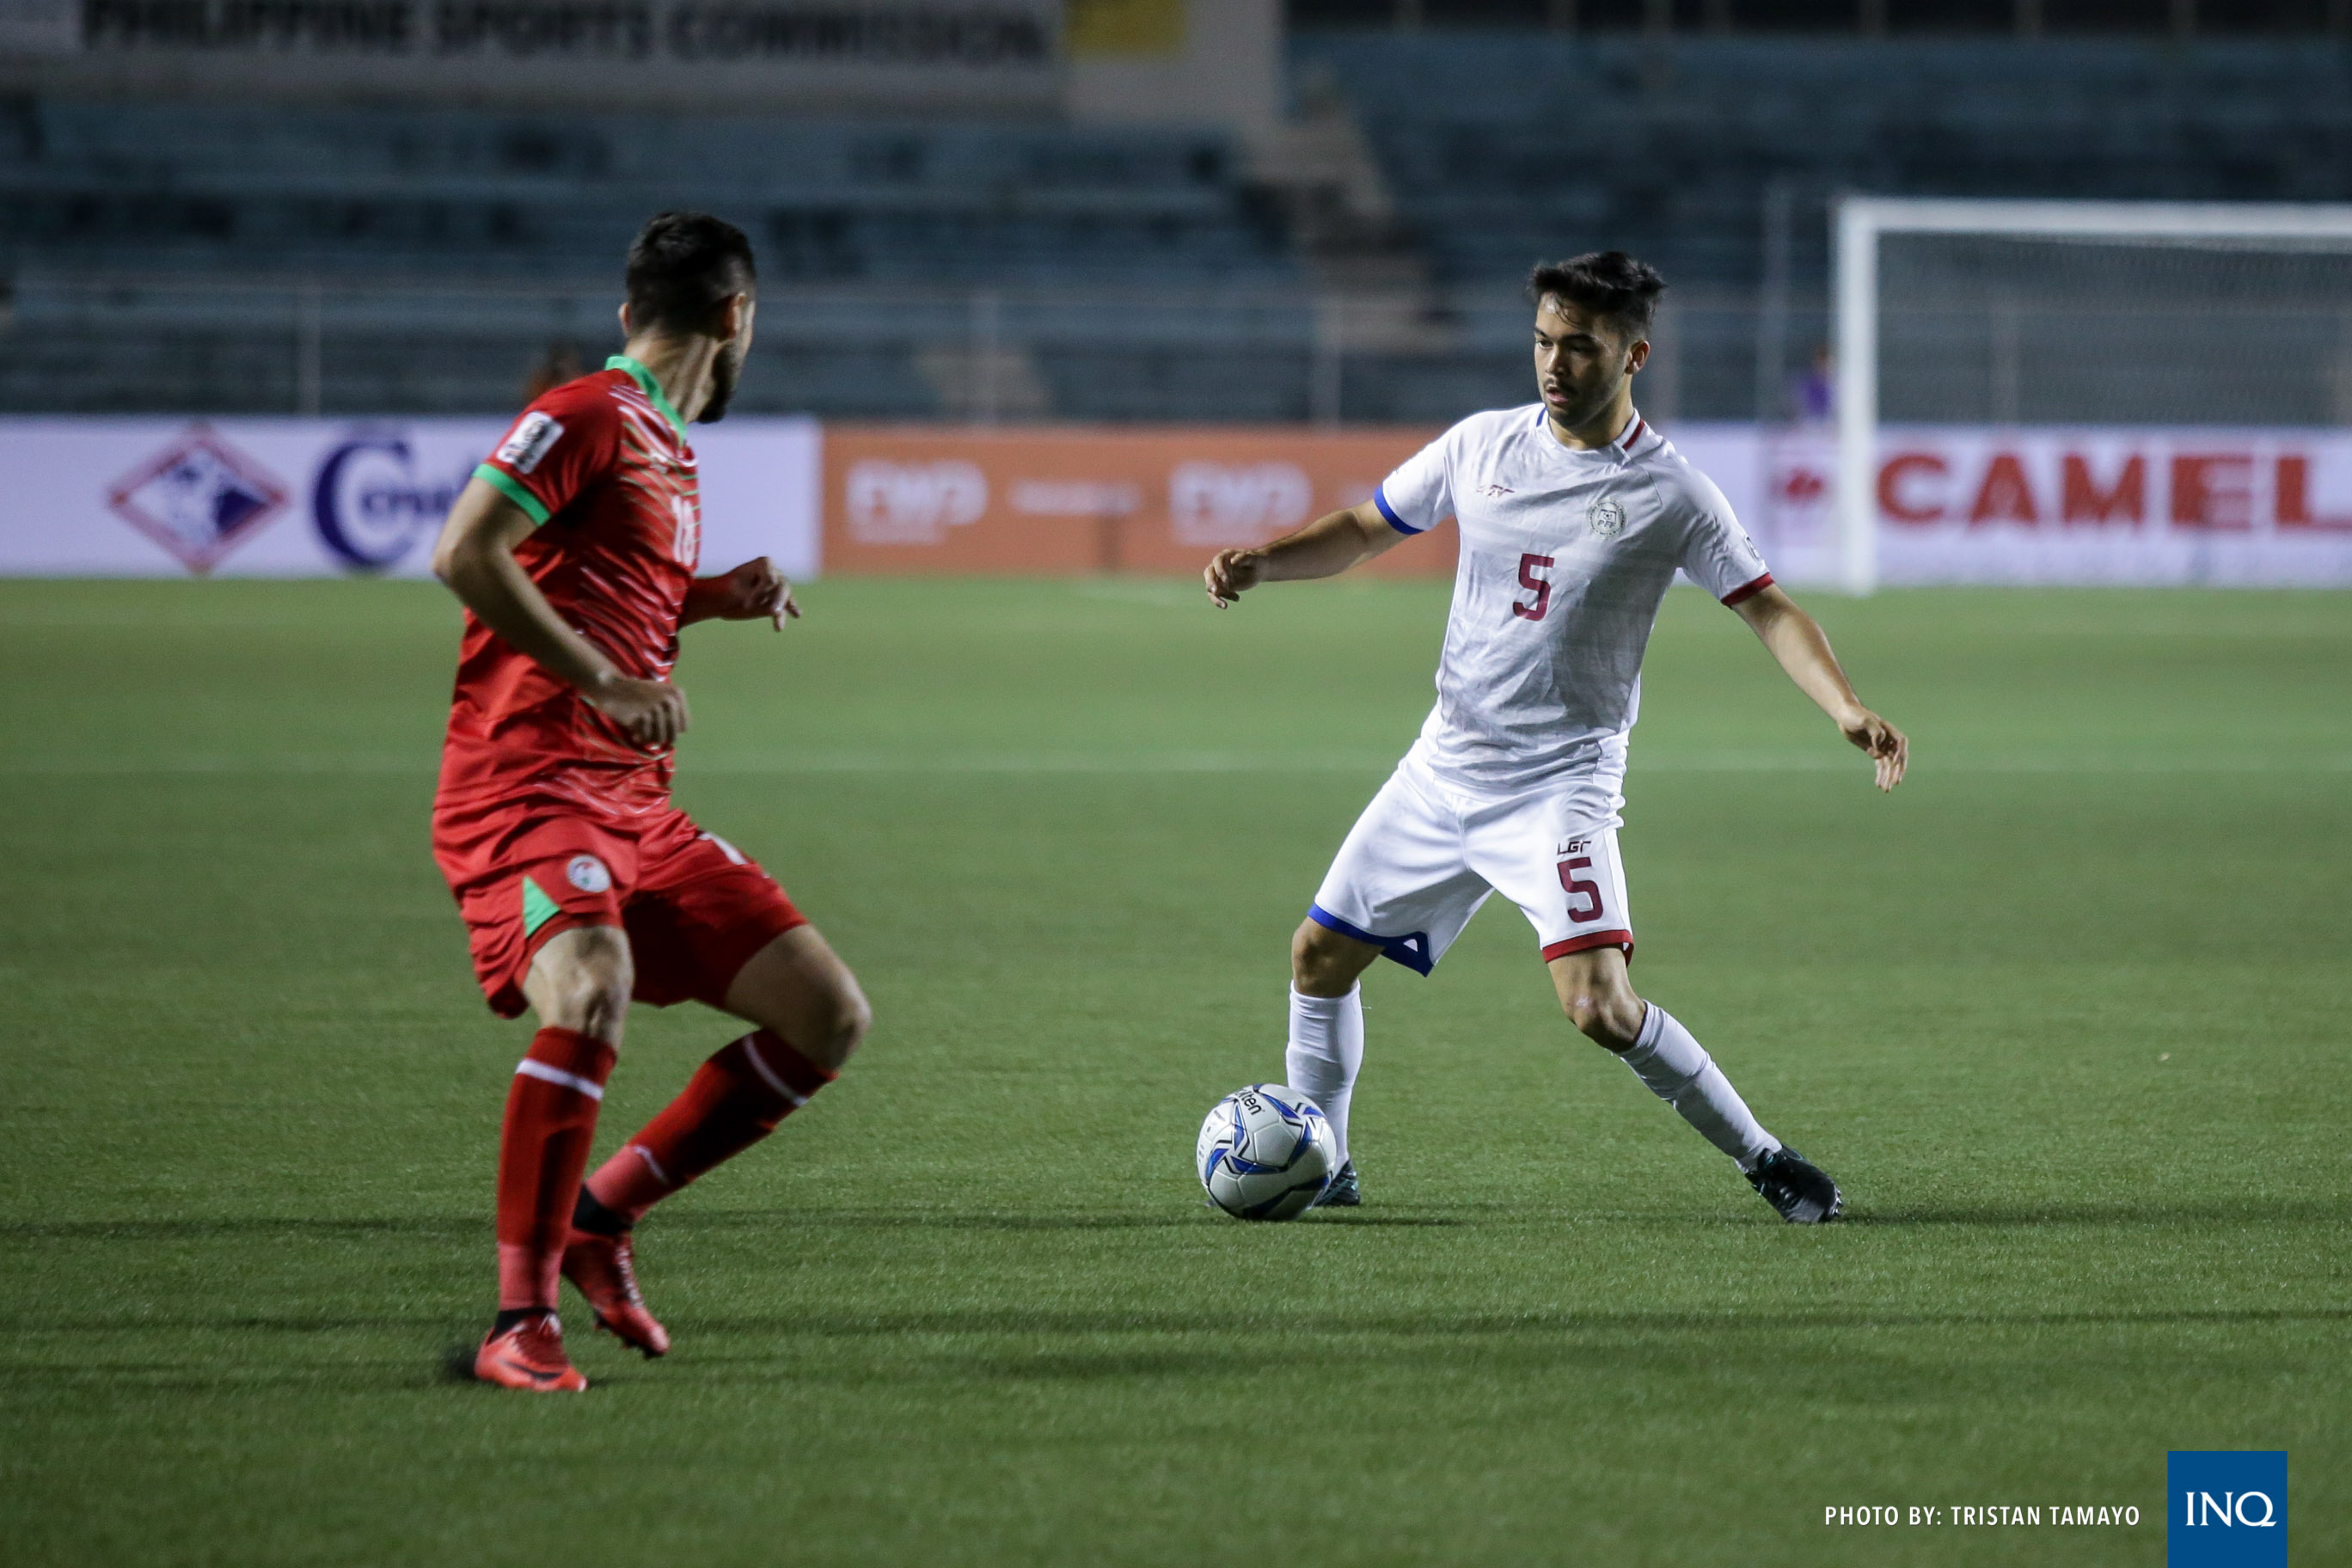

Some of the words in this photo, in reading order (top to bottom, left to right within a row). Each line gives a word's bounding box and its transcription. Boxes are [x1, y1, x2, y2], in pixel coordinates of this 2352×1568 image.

[435, 0, 650, 58] SPORTS
[669, 7, 1045, 66] COMMISSION
[1877, 452, 2352, 530] CAMEL
[1512, 553, 1555, 622] 5
[1557, 857, 1604, 923] 5
